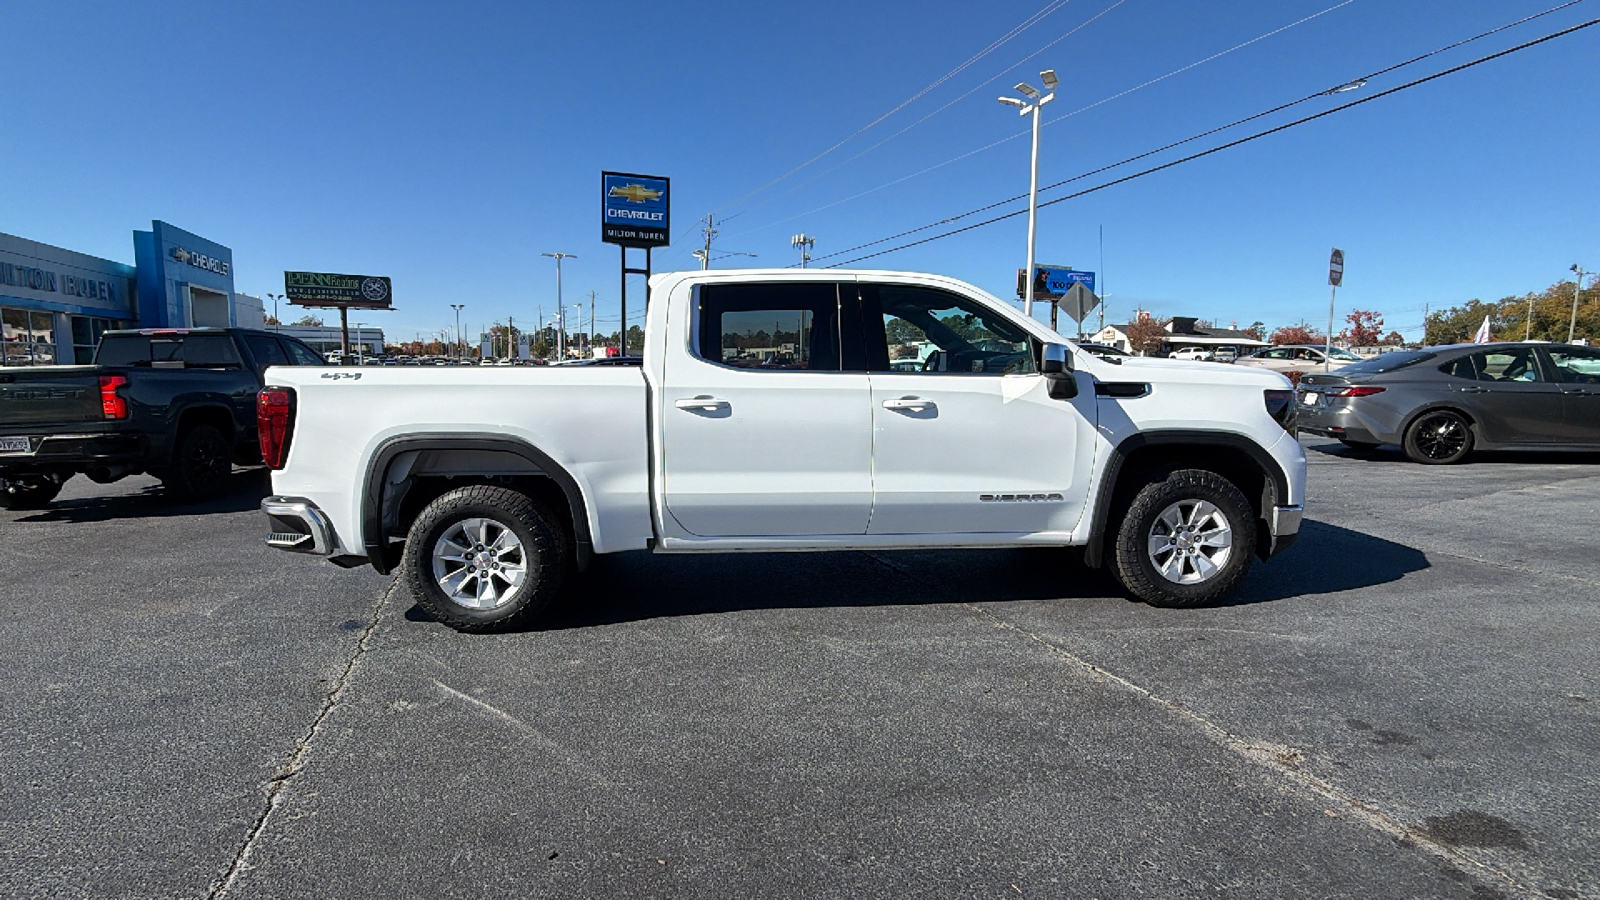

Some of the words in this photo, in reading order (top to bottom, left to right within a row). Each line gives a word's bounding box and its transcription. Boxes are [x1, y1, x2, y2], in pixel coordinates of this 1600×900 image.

[607, 208, 664, 221] CHEVROLET
[607, 229, 636, 238] MILTON
[639, 231, 665, 240] RUBEN
[191, 251, 229, 276] CHEVROLET
[287, 272, 333, 287] PENN
[61, 274, 115, 301] RUBEN
[979, 493, 1064, 502] SIERRA
